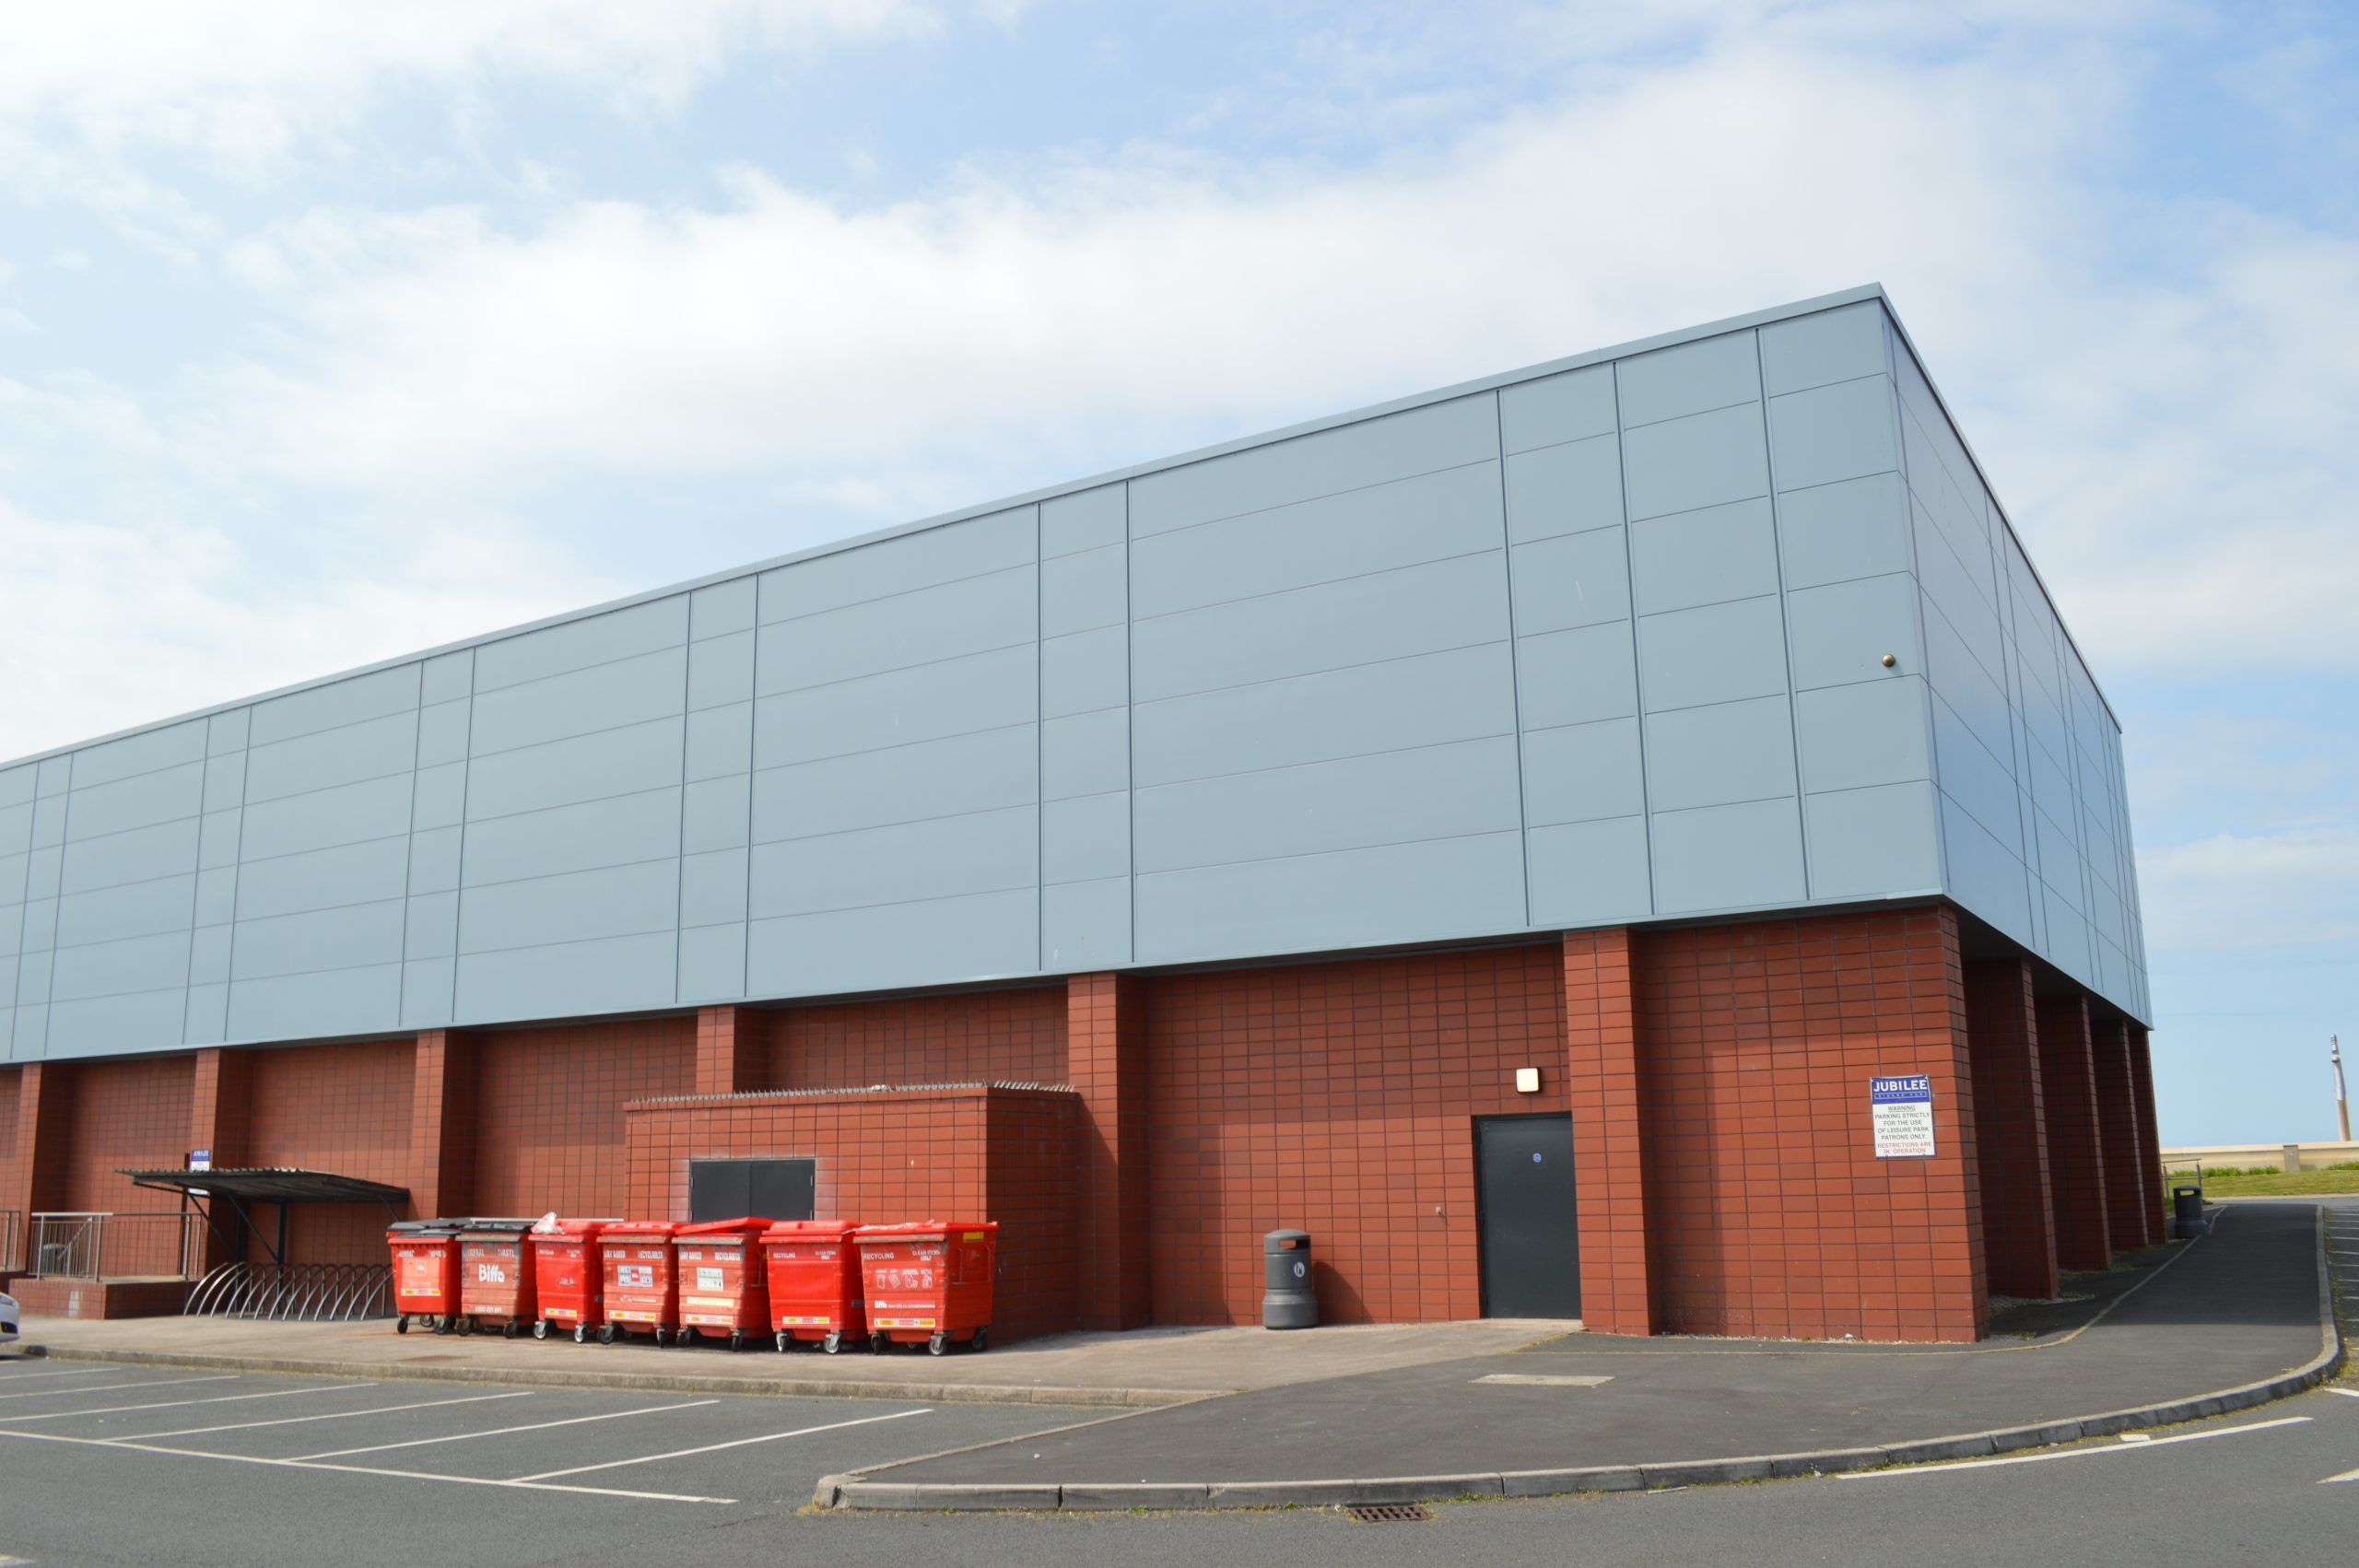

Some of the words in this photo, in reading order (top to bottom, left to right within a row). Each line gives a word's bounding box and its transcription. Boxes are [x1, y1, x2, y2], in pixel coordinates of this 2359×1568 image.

[1873, 1080, 1928, 1093] JUBILEE
[863, 1252, 894, 1260] RECYCLING
[478, 1263, 505, 1283] Biffa
